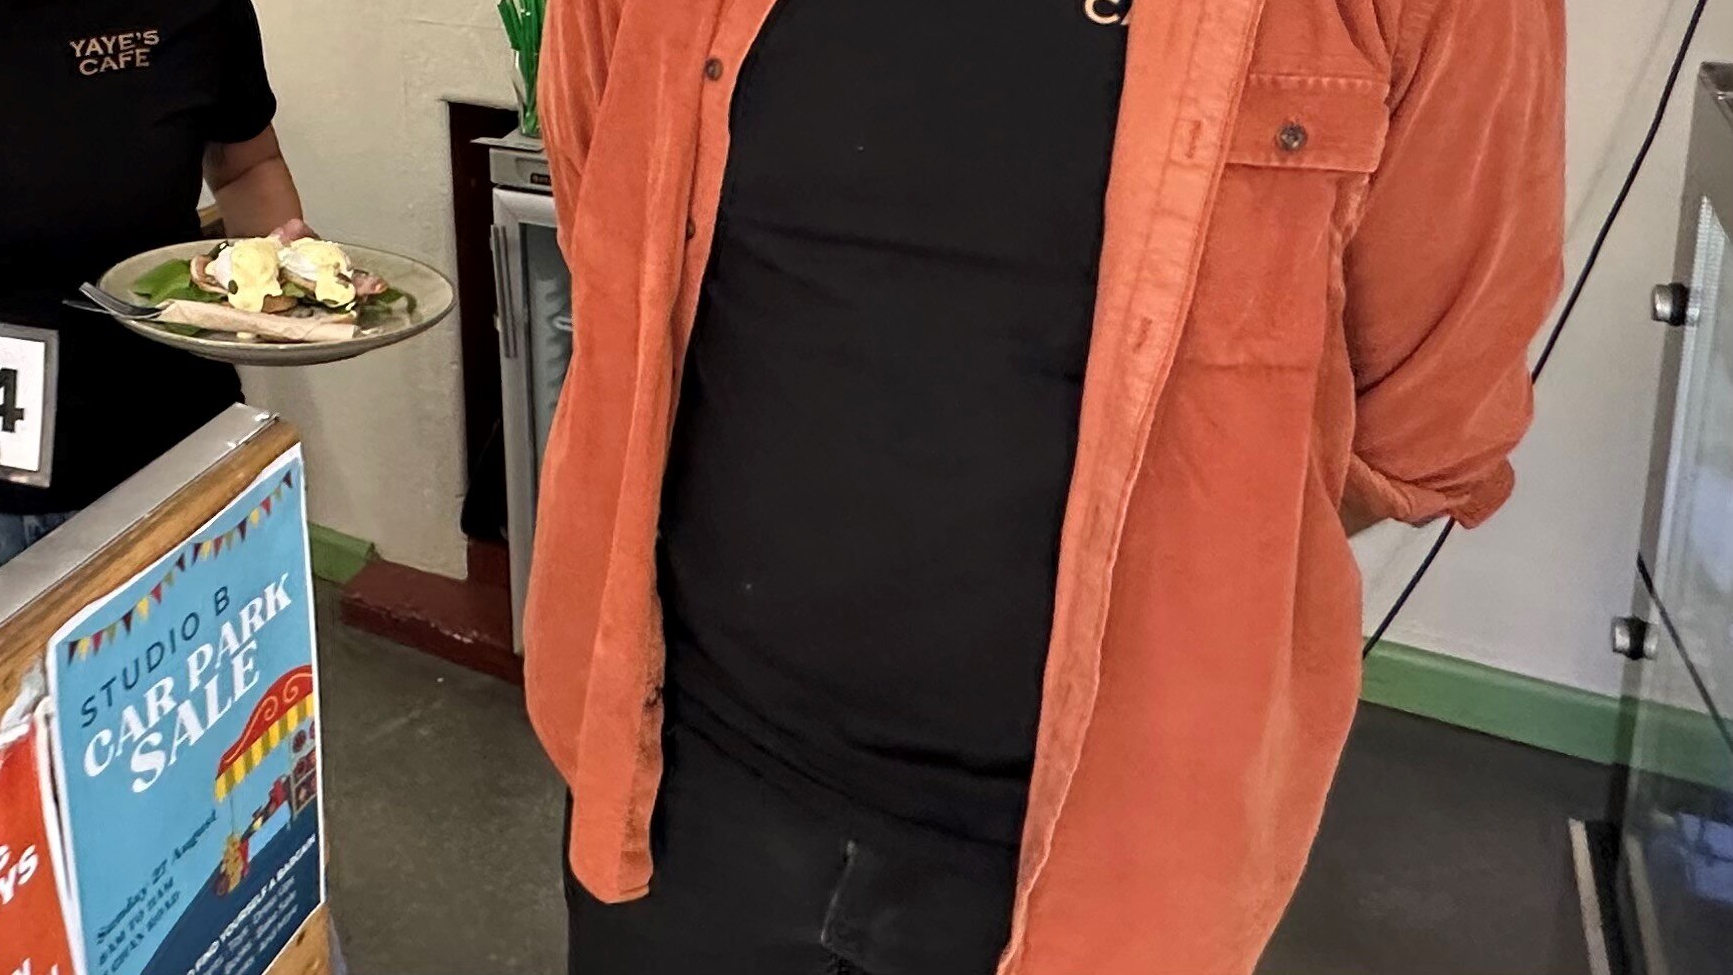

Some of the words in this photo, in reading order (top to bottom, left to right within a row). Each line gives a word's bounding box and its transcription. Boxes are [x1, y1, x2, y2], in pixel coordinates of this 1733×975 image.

[69, 29, 161, 58] YAYE'S
[78, 47, 152, 77] CAFE
[80, 611, 201, 728] STUDIO
[213, 584, 231, 616] B
[82, 675, 178, 778] CAR
[186, 571, 293, 694] PARK
[129, 638, 261, 794] SALE
